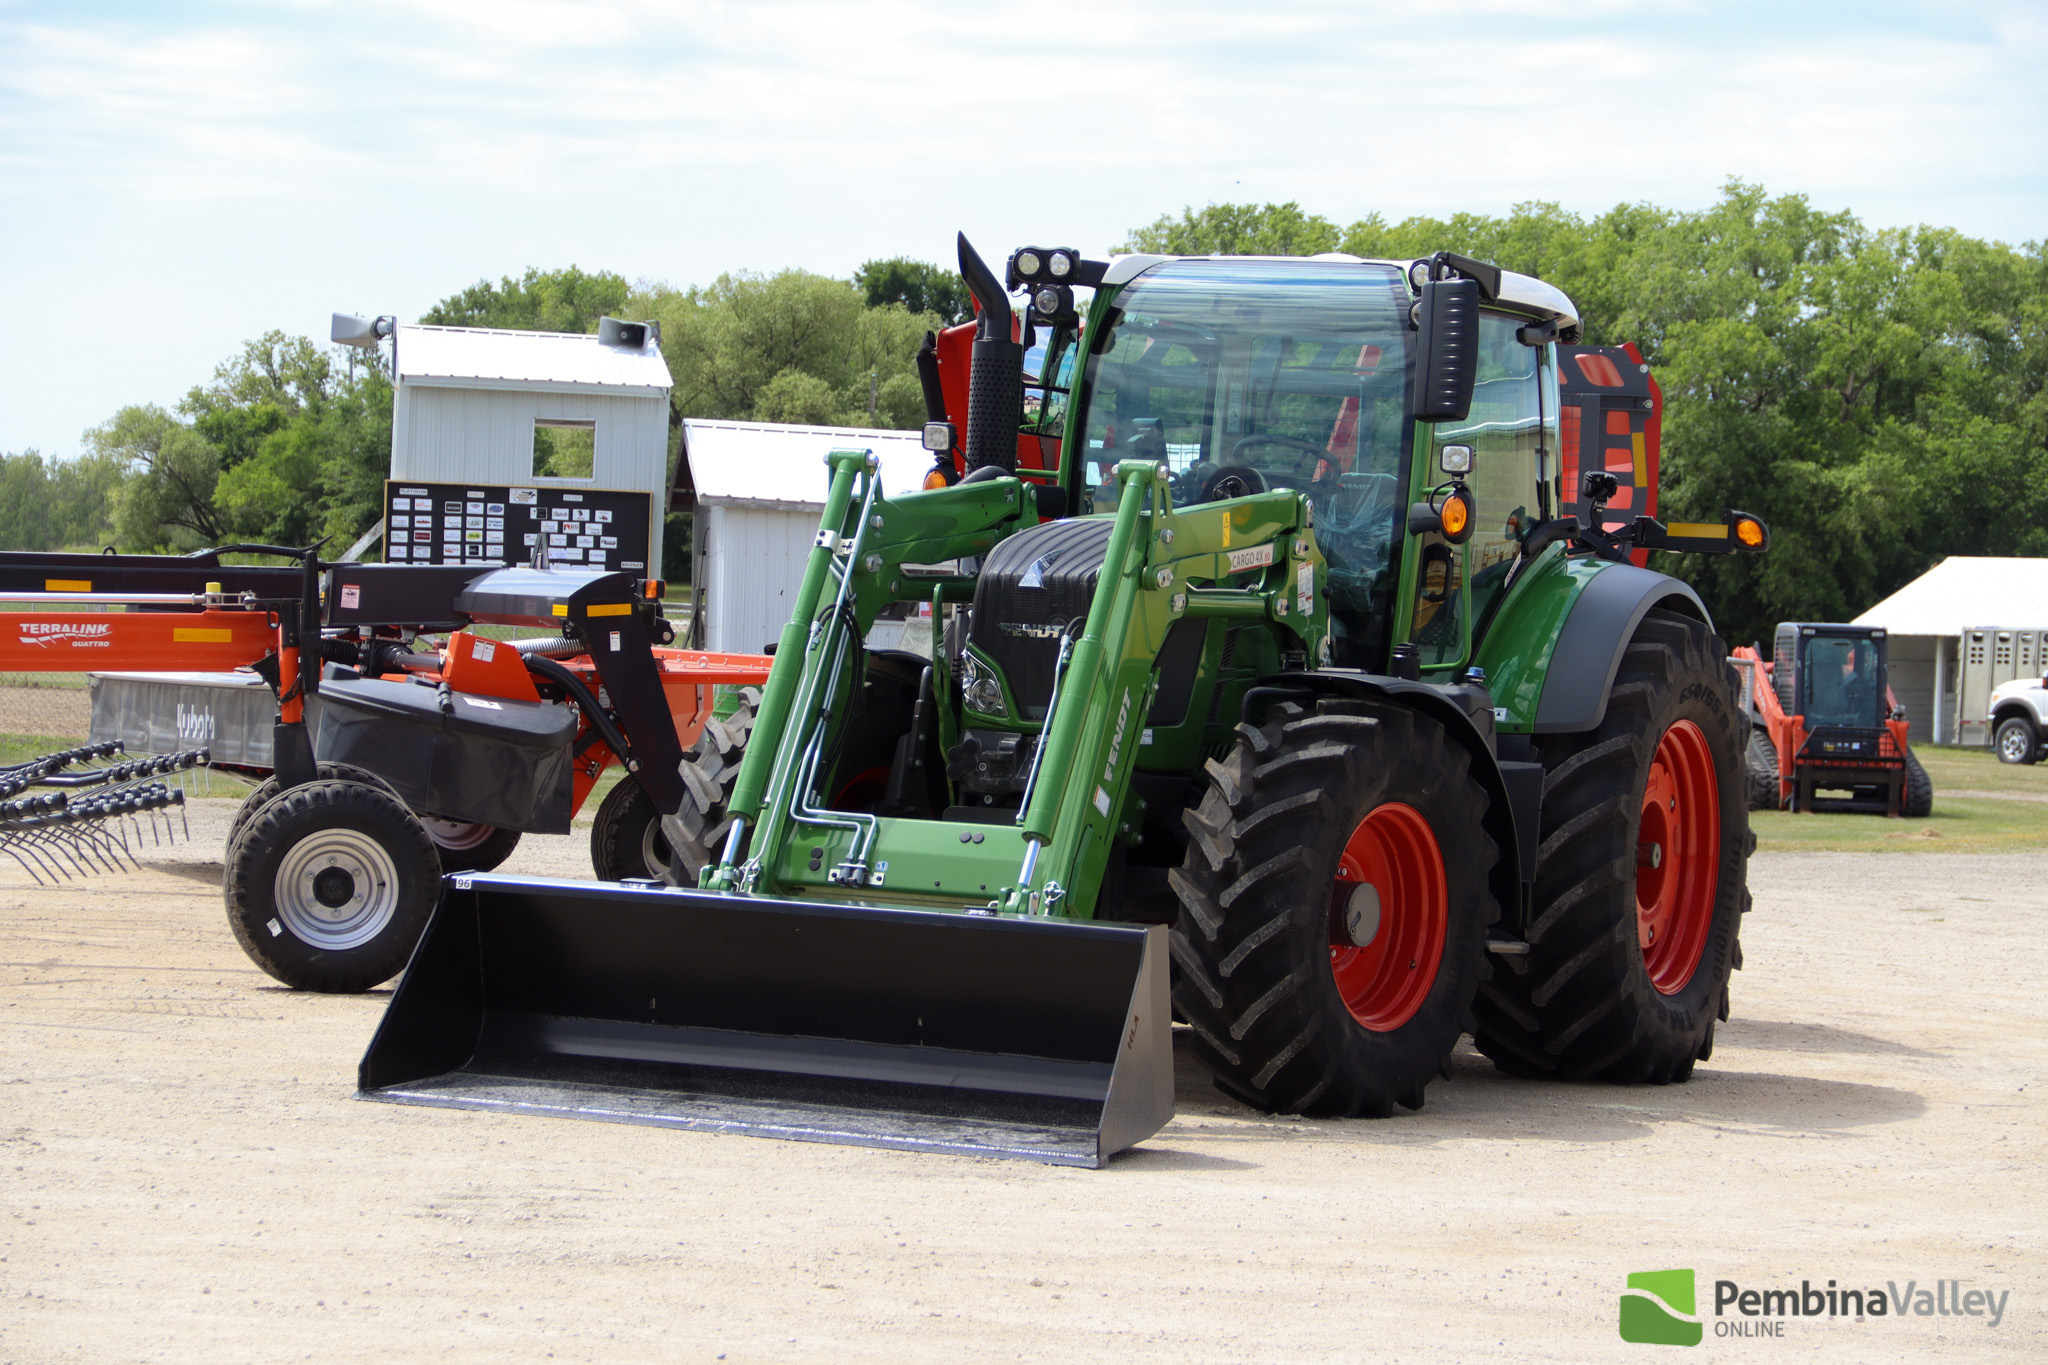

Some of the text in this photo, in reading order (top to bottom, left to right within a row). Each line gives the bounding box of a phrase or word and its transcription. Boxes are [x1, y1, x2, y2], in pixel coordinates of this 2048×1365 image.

[1232, 553, 1254, 568] CARGO
[1255, 550, 1264, 563] 4X
[20, 623, 110, 635] TERRALINK
[1000, 622, 1064, 639] FENDT
[177, 703, 215, 740] Kubota
[1103, 685, 1131, 782] FENDT
[457, 879, 470, 888] 96
